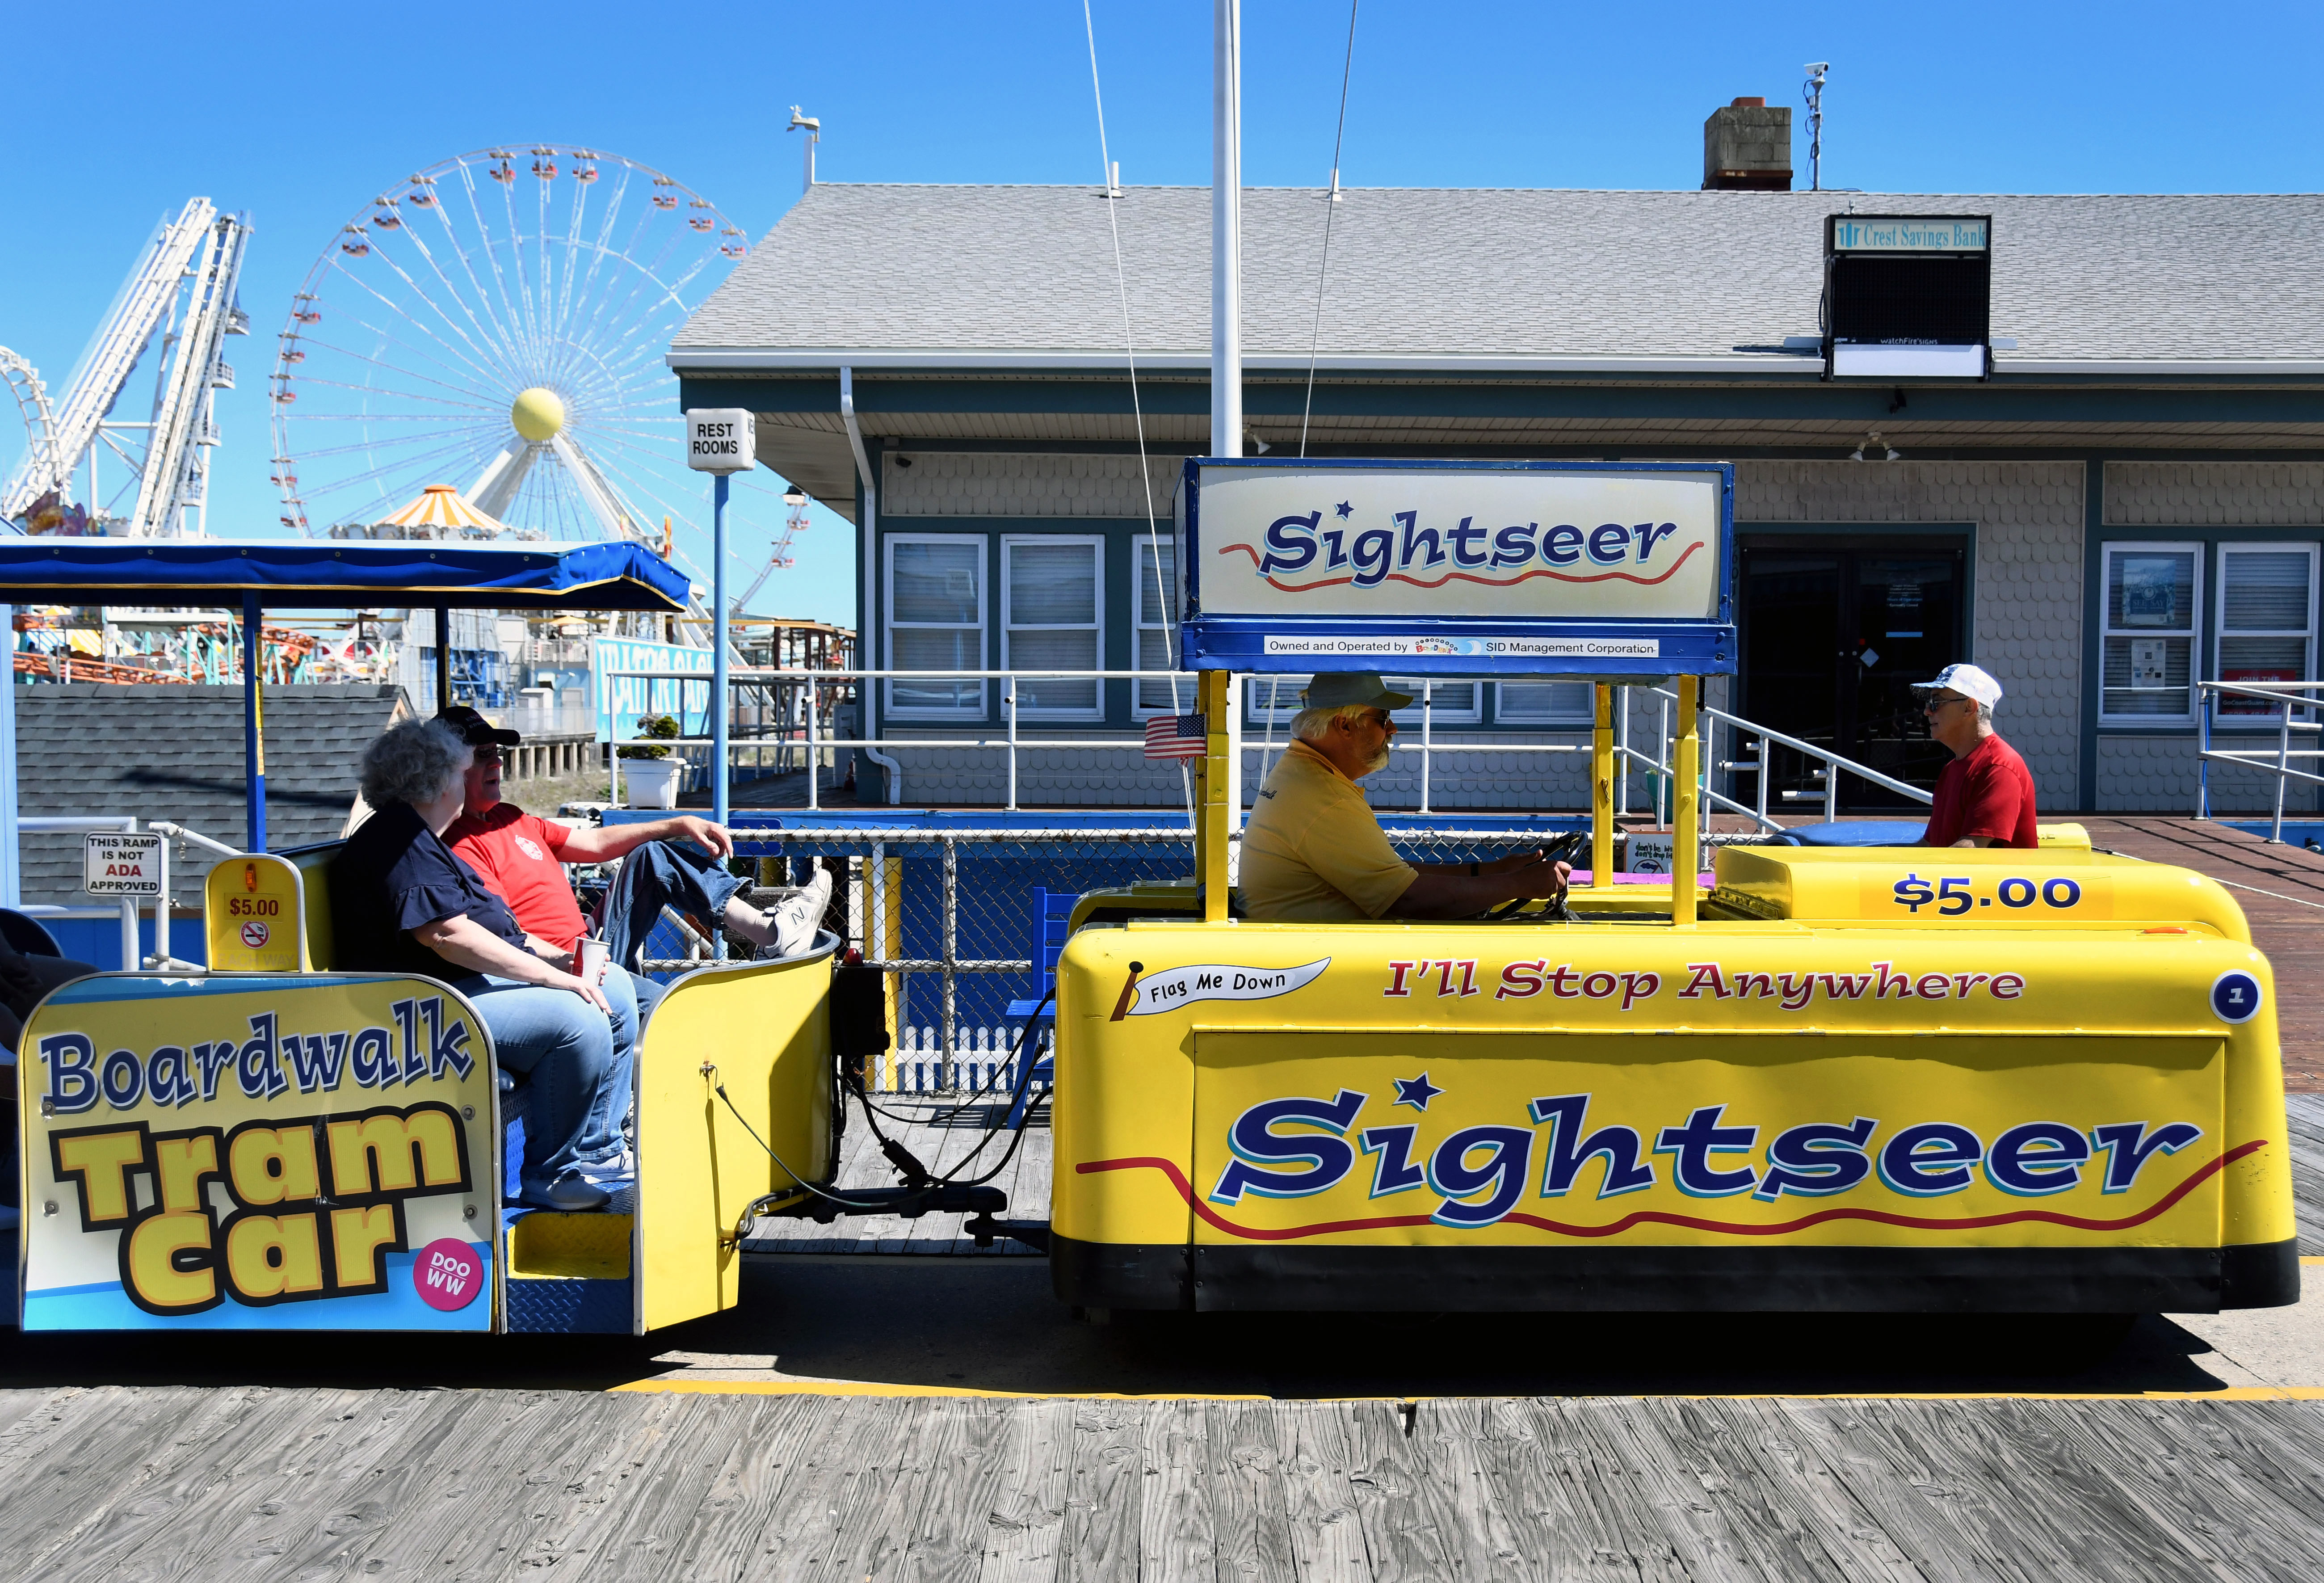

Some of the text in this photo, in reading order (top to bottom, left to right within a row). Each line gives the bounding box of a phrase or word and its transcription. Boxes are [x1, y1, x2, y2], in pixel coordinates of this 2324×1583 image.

[1864, 223, 1986, 249] Crest Savings Bank
[697, 423, 734, 437] REST
[693, 440, 738, 455] ROOMS
[1256, 500, 1677, 590] Sightseer
[1269, 641, 1309, 651] Owned
[1313, 641, 1334, 651] and
[1337, 641, 1390, 653] Operated
[1394, 642, 1408, 653] by
[1486, 642, 1506, 652] SID
[1510, 642, 1584, 654] Management
[1587, 643, 1654, 655] Corporation
[89, 838, 158, 848] THIS RAMP
[1635, 842, 1652, 851] don't
[1653, 842, 1661, 852] be
[102, 851, 144, 860] IS NOT
[105, 864, 143, 877] ADA
[90, 881, 157, 891] APPROVED
[1893, 873, 2082, 916] $5.00
[229, 897, 279, 917] $5.00
[789, 905, 805, 926] N
[1151, 973, 1286, 1003] Flag Me Down
[1383, 957, 2026, 1011] I'll Stop Anywhere
[2228, 988, 2244, 1003] 1
[38, 995, 475, 1115] Boardwalk
[1208, 1070, 2204, 1229] Sightseer
[48, 1101, 473, 1234] Tram
[431, 1251, 471, 1277] DOO
